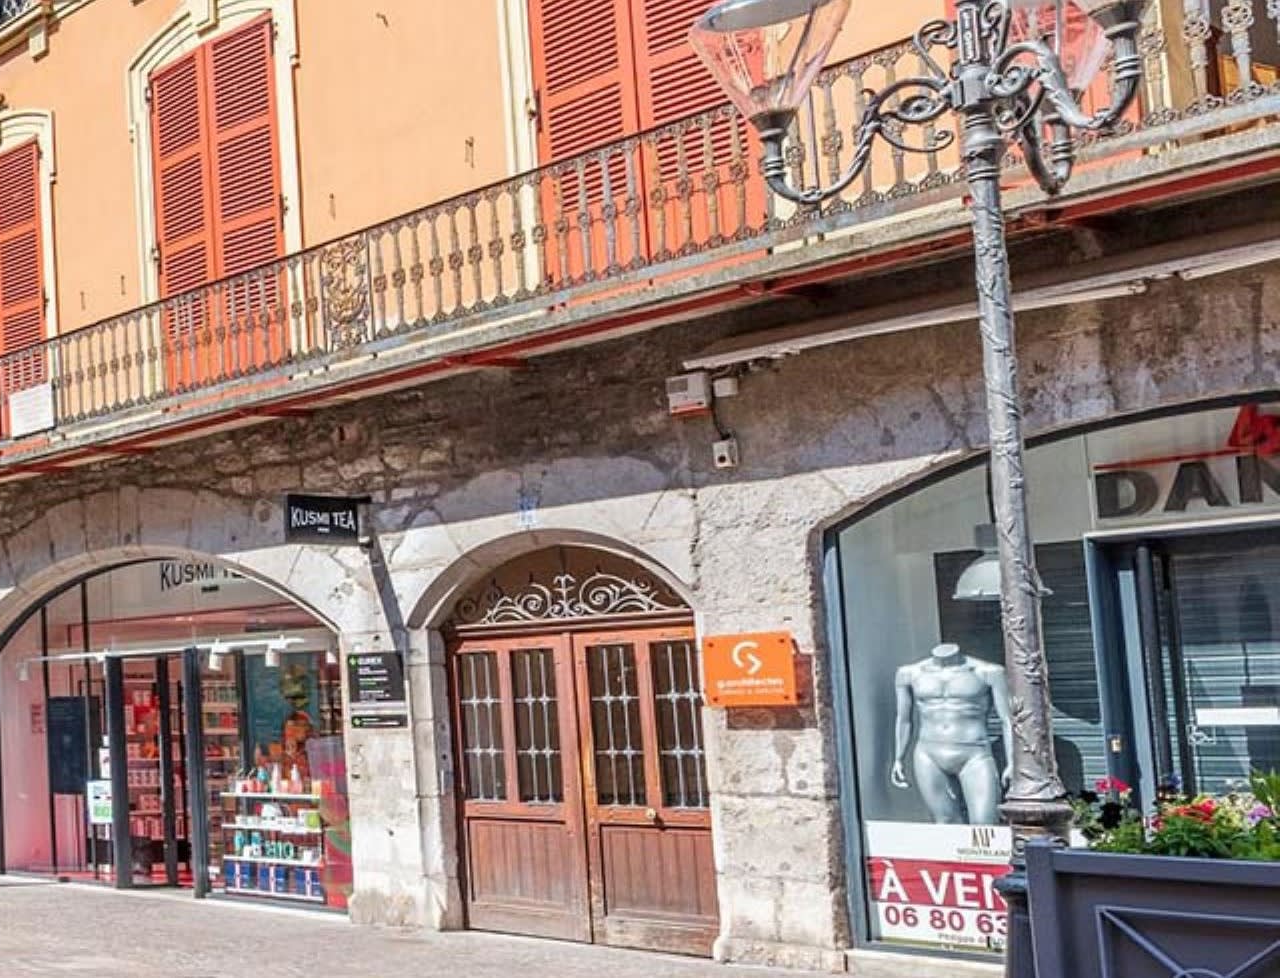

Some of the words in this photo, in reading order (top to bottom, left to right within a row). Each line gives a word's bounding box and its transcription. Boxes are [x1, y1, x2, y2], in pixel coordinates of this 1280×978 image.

[291, 506, 330, 528] KUSMI
[332, 510, 356, 531] TEA
[160, 562, 214, 591] KUSMI
[956, 848, 1010, 857] MONTBLAN
[879, 860, 909, 903] À
[919, 869, 1009, 910] VEN
[885, 906, 919, 928] 06
[929, 908, 965, 932] 80
